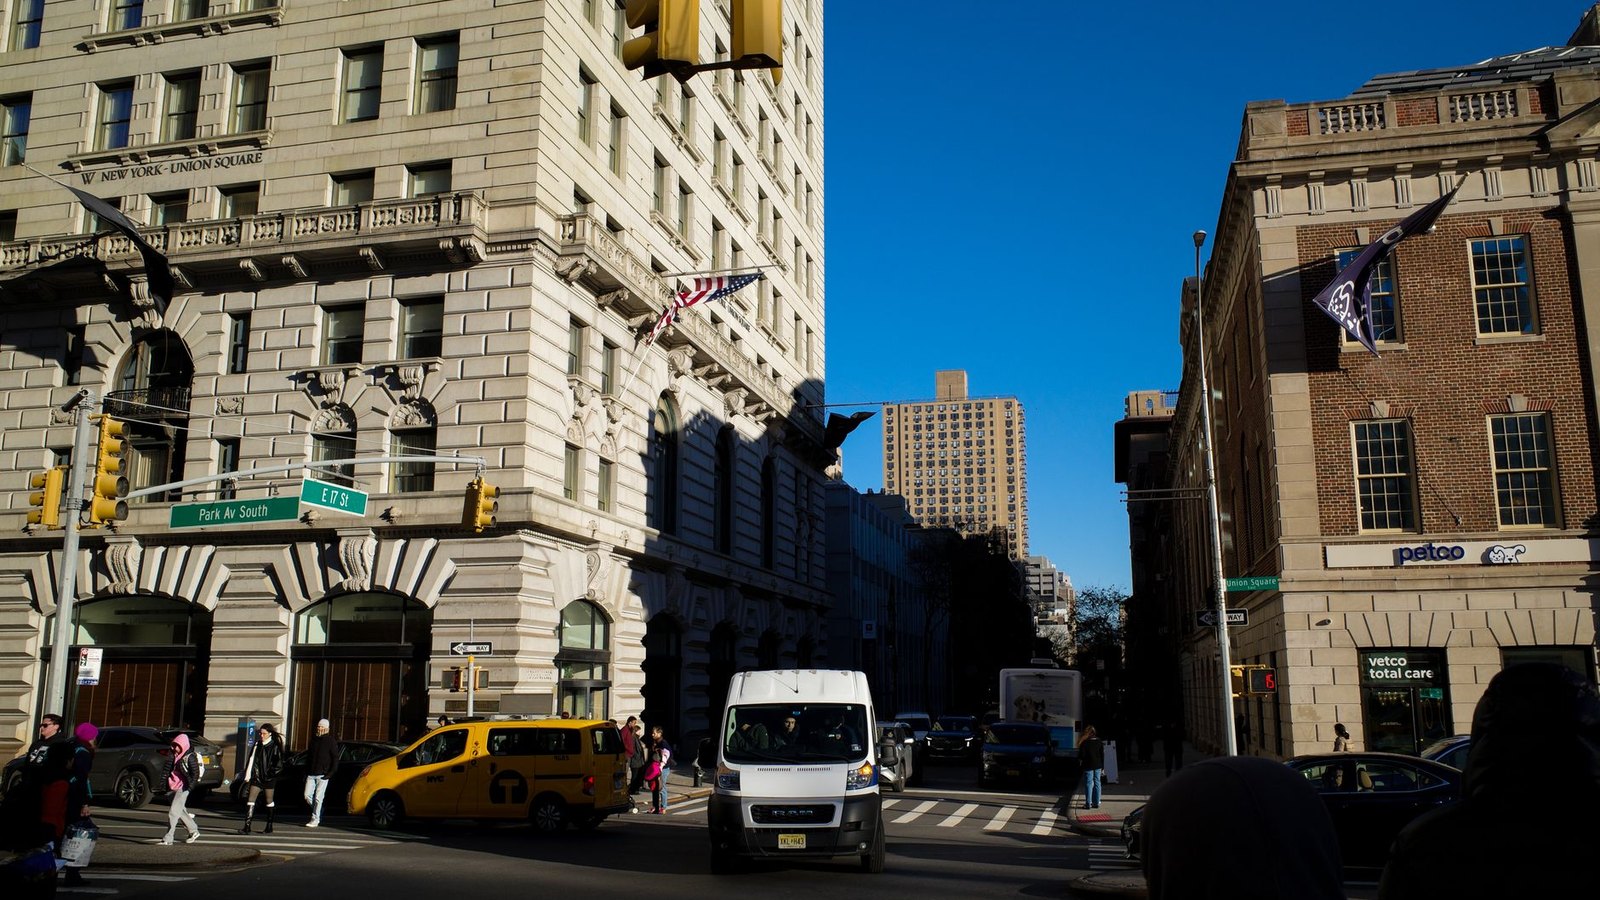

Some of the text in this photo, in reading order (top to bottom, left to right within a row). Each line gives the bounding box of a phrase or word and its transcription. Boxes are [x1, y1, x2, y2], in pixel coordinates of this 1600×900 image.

[81, 172, 96, 185] W
[100, 169, 129, 182] NEW
[130, 164, 163, 179] YORK
[170, 158, 213, 174] UNION
[214, 153, 263, 169] SQUARE
[322, 488, 349, 508] E 17 St
[199, 504, 268, 521] Park Av South
[1399, 543, 1465, 565] petco
[1226, 578, 1277, 587] Union Square
[1368, 655, 1407, 667] vetco
[1369, 668, 1435, 679] total care
